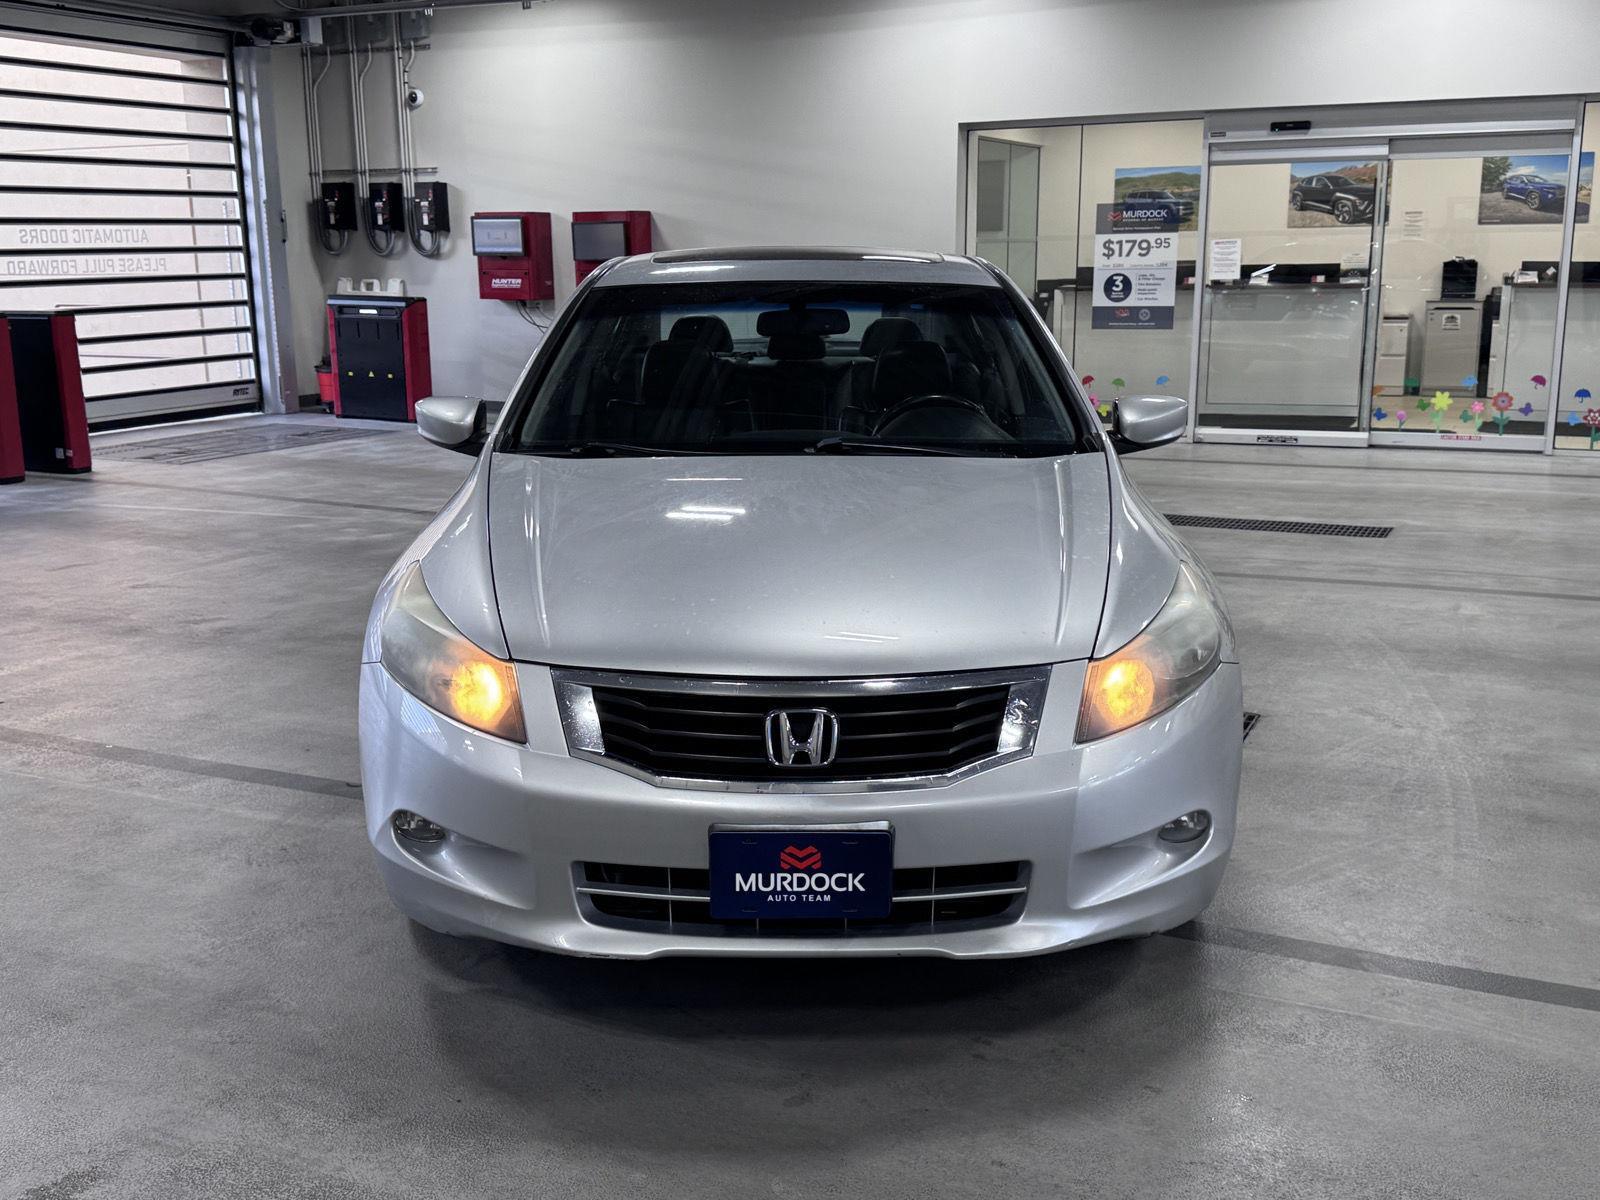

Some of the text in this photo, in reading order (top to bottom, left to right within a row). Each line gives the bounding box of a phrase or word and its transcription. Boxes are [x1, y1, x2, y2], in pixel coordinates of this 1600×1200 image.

[1122, 209, 1168, 218] MURDOCK
[1112, 275, 1124, 291] 3
[735, 872, 866, 892] MURDOCK
[767, 894, 831, 902] AUTO TEAM
